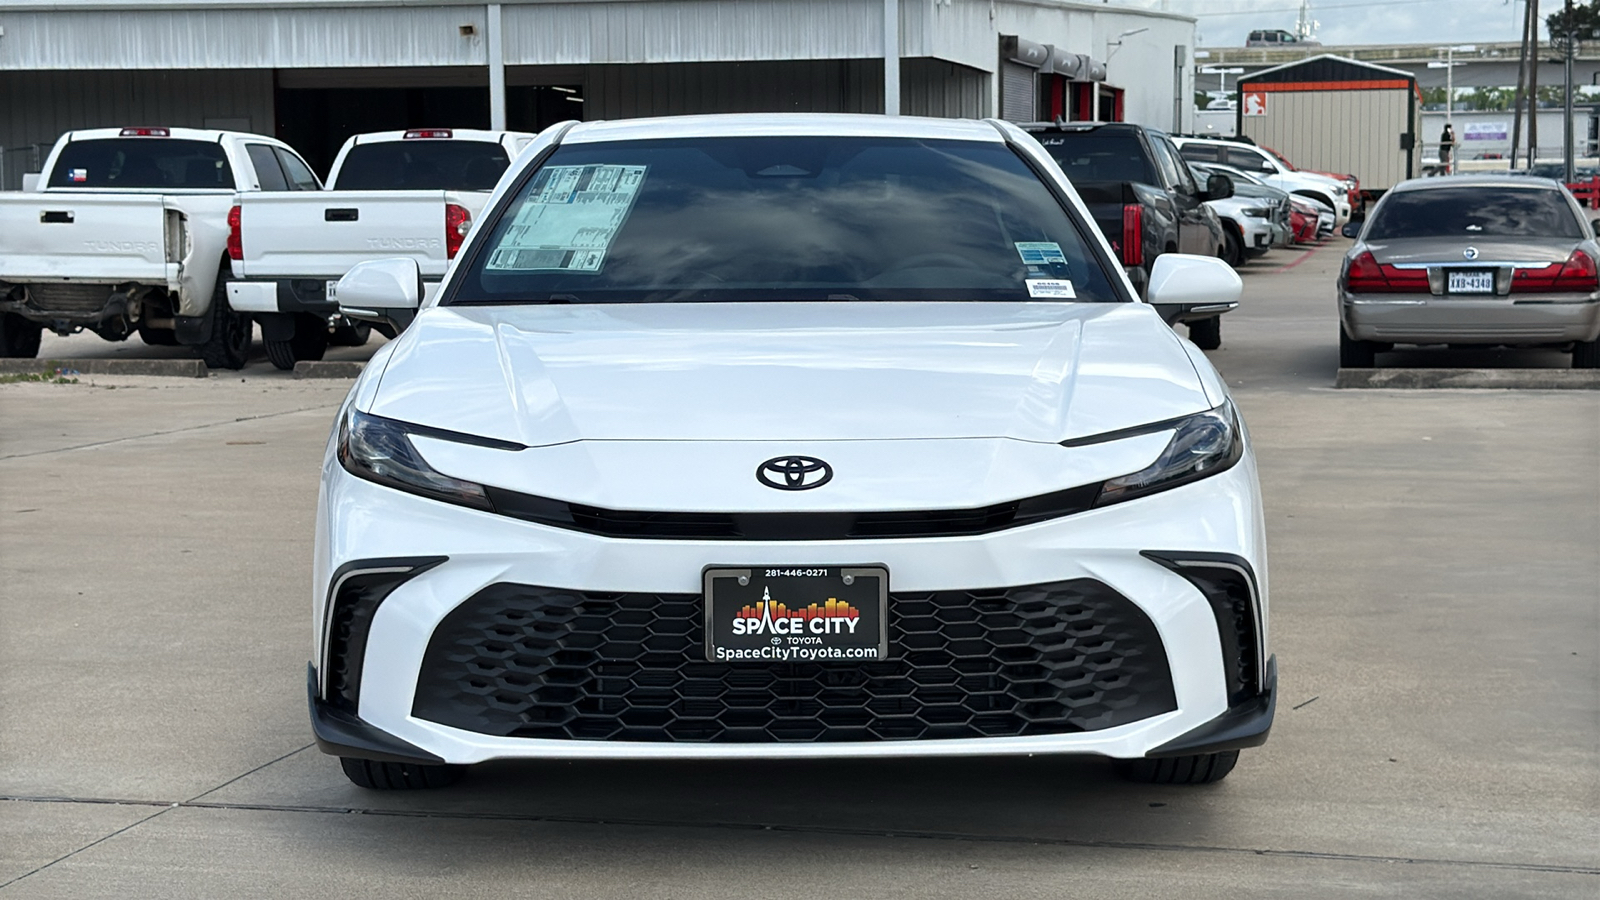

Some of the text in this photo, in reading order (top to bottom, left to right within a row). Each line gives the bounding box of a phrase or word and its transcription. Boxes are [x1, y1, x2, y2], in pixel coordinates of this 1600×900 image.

[83, 240, 159, 252] TUNDRA
[367, 237, 440, 249] TUNDRA
[765, 569, 828, 577] 281-446-0271
[732, 617, 860, 635] SPACE CITY
[787, 637, 823, 645] TOYOTA
[716, 646, 878, 661] SpaceCityToyota.com
